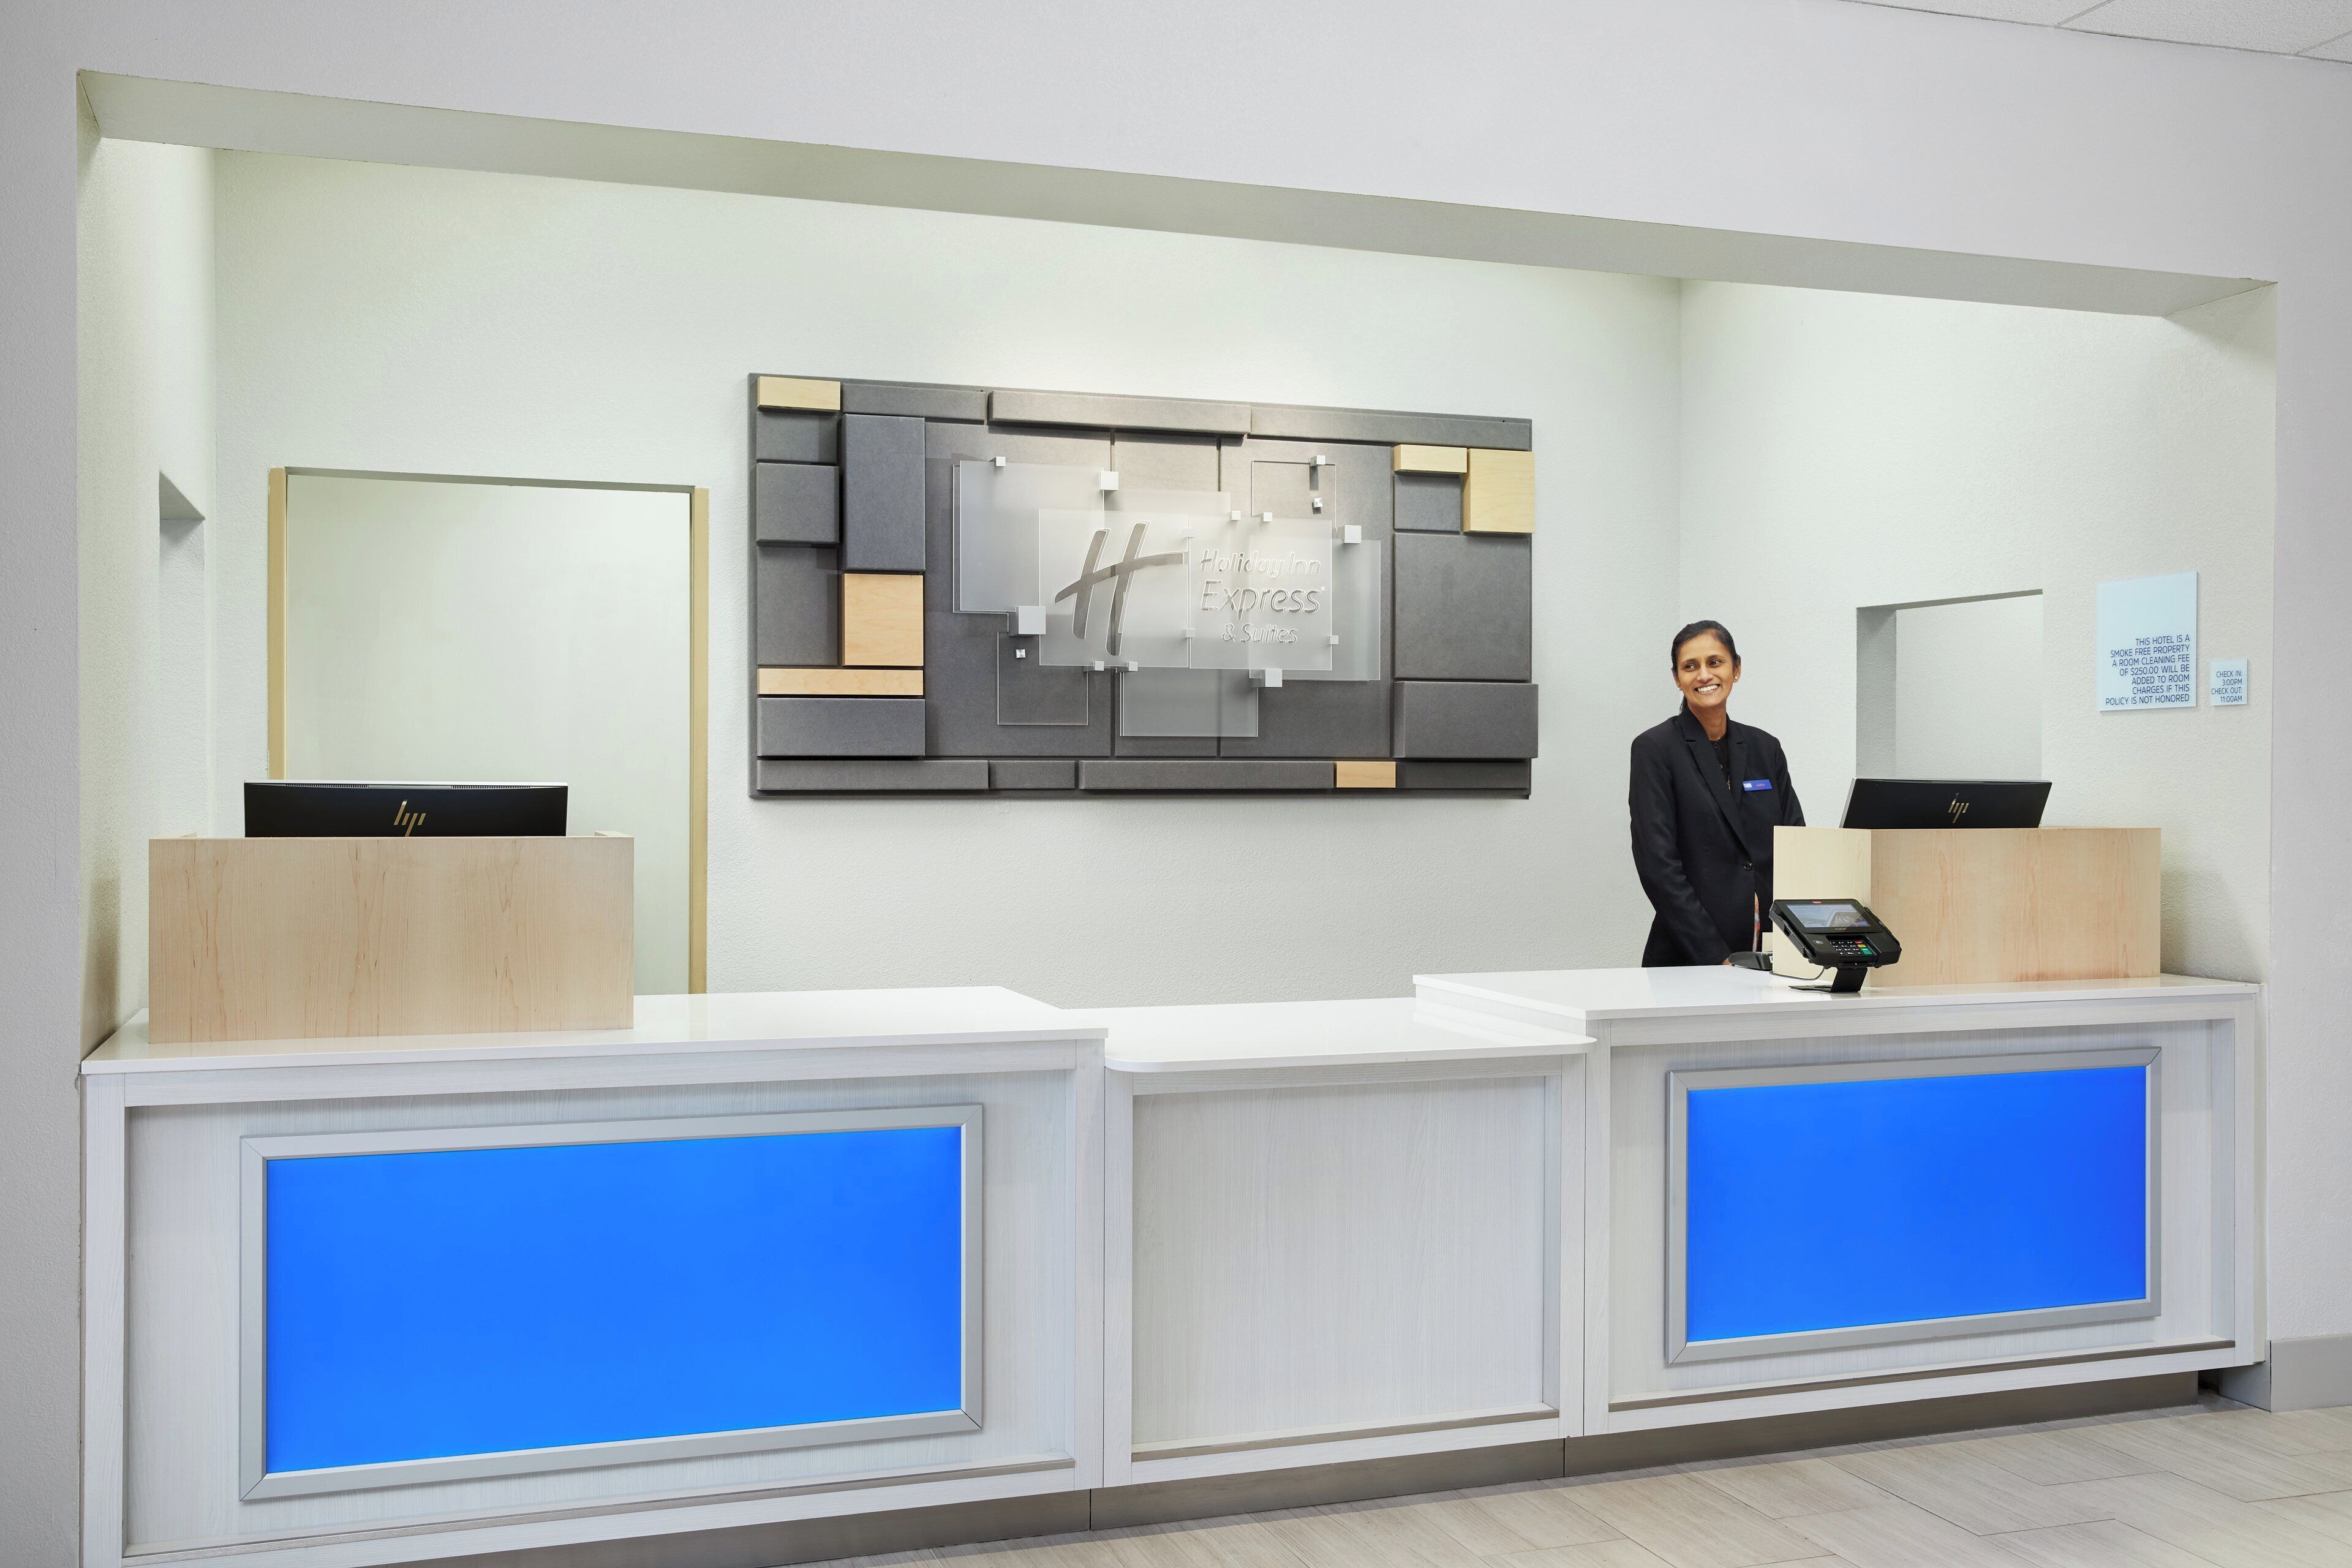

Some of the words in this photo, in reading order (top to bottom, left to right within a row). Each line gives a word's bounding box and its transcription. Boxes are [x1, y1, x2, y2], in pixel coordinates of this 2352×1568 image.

[1200, 549, 1284, 579] Holiday
[1287, 552, 1321, 575] Inn
[1221, 623, 1236, 643] &
[1240, 623, 1298, 644] Suites
[2152, 636, 2174, 644] HOTEL
[2110, 649, 2133, 658] SMOKE
[2135, 647, 2151, 656] FREE
[2153, 644, 2190, 654] PROPERTY
[2119, 658, 2139, 666] ROOM
[2141, 655, 2176, 665] CLEANING
[2130, 666, 2158, 676] $250.00
[2132, 676, 2155, 685] ADDED
[2132, 685, 2164, 695] CHARGES
[2174, 684, 2190, 692] THIS
[2139, 695, 2153, 704] NOT
[2155, 694, 2190, 703] HONORED
[393, 799, 426, 837] hp
